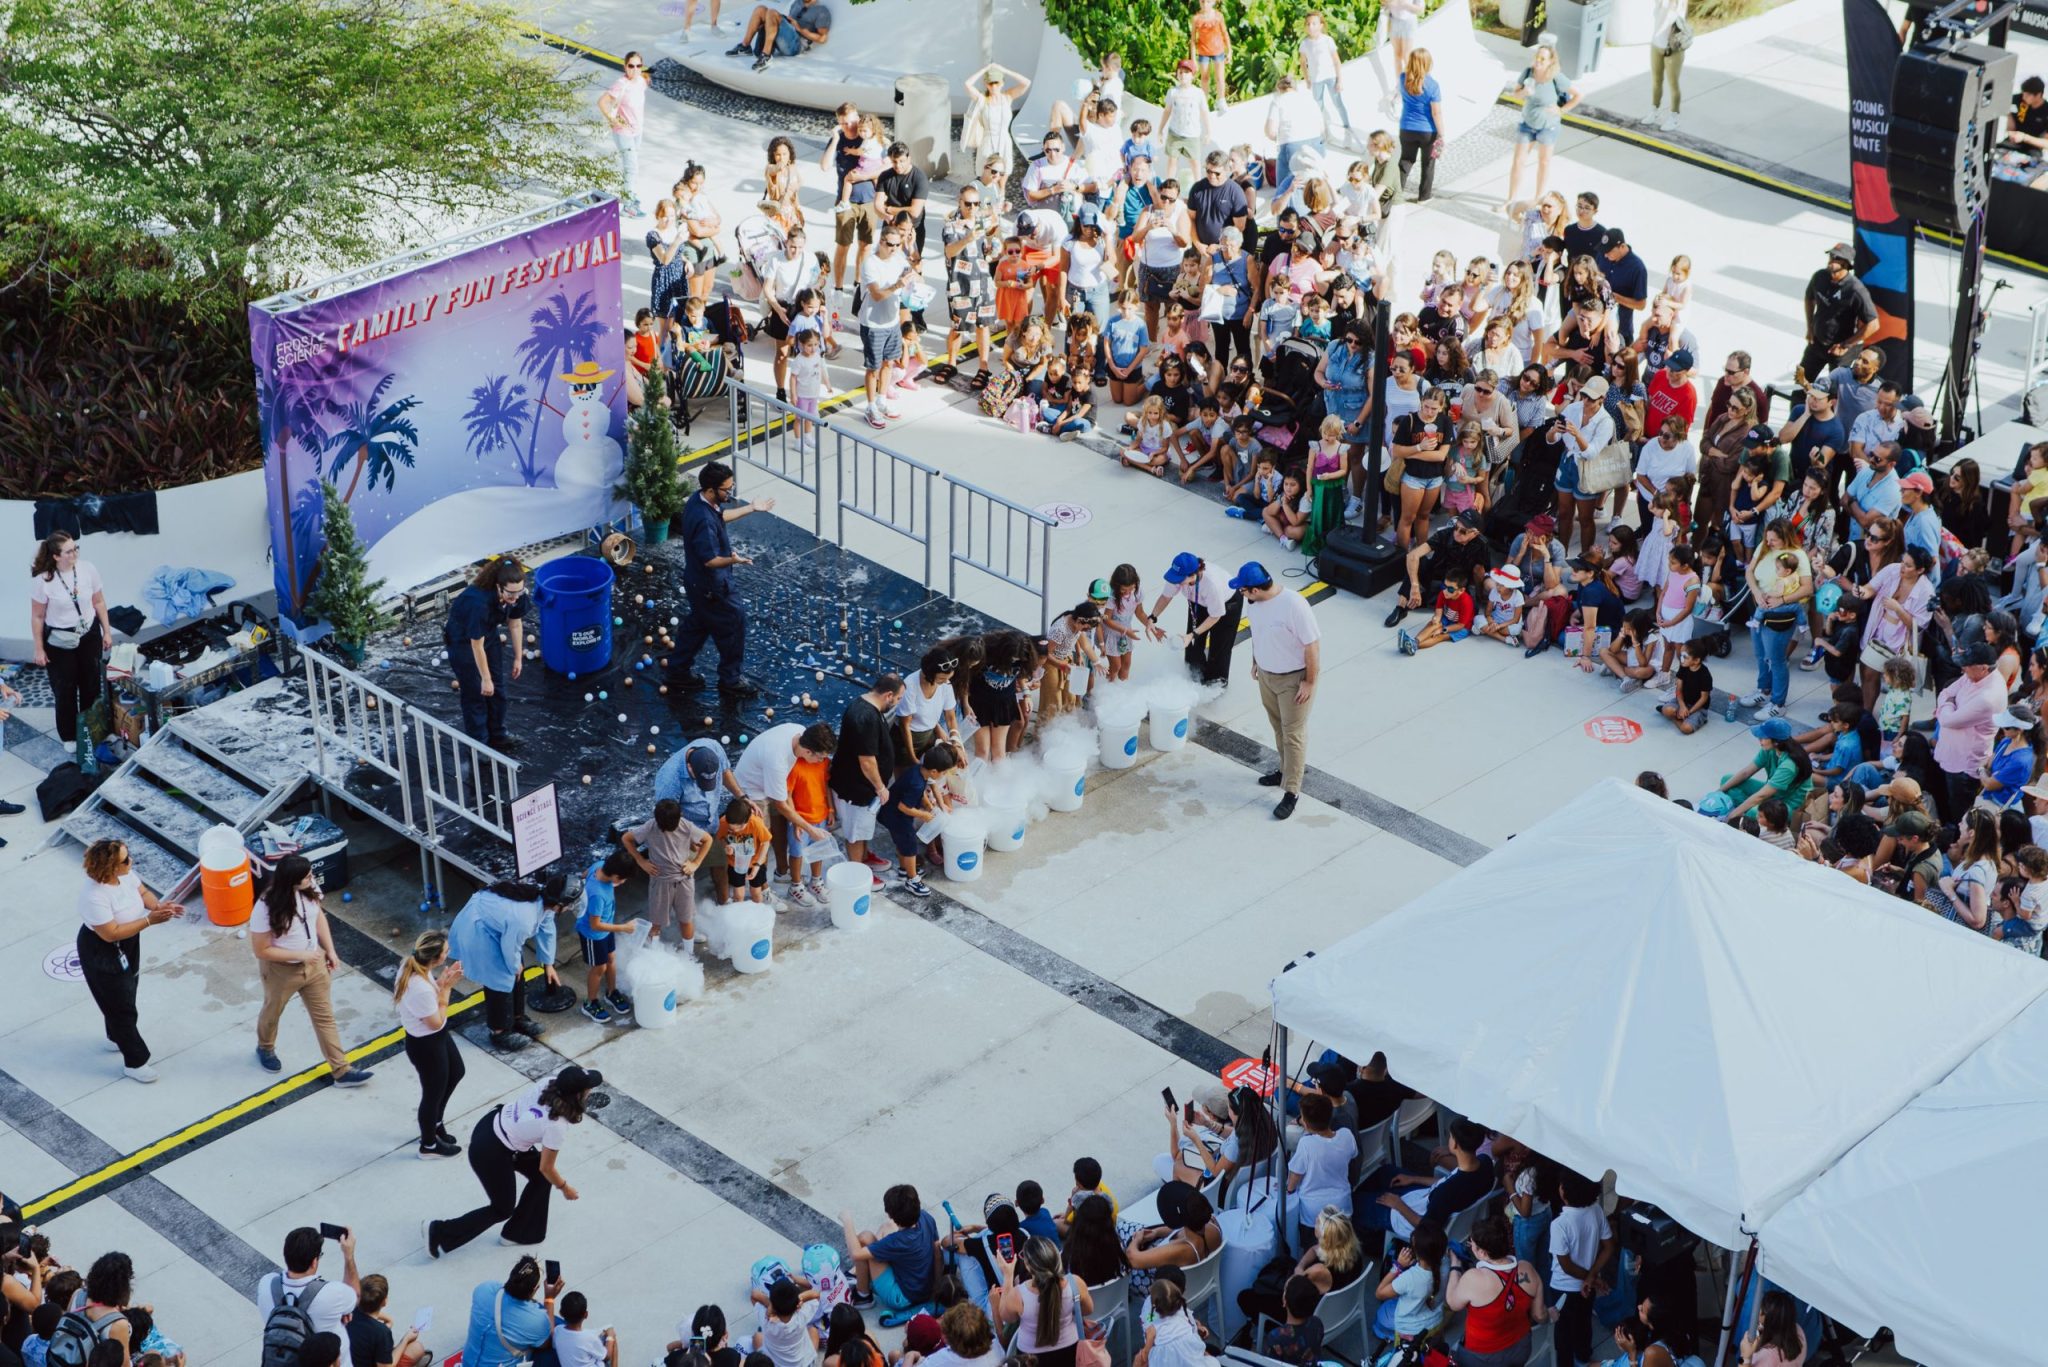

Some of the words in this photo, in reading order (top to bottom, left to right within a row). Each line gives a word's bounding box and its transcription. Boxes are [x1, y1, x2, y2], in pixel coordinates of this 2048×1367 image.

[337, 294, 438, 352] FAMILY
[444, 275, 495, 315] FUN
[500, 230, 621, 295] FESTIVAL
[277, 343, 326, 369] SCIENCE
[1601, 719, 1627, 740] STOP
